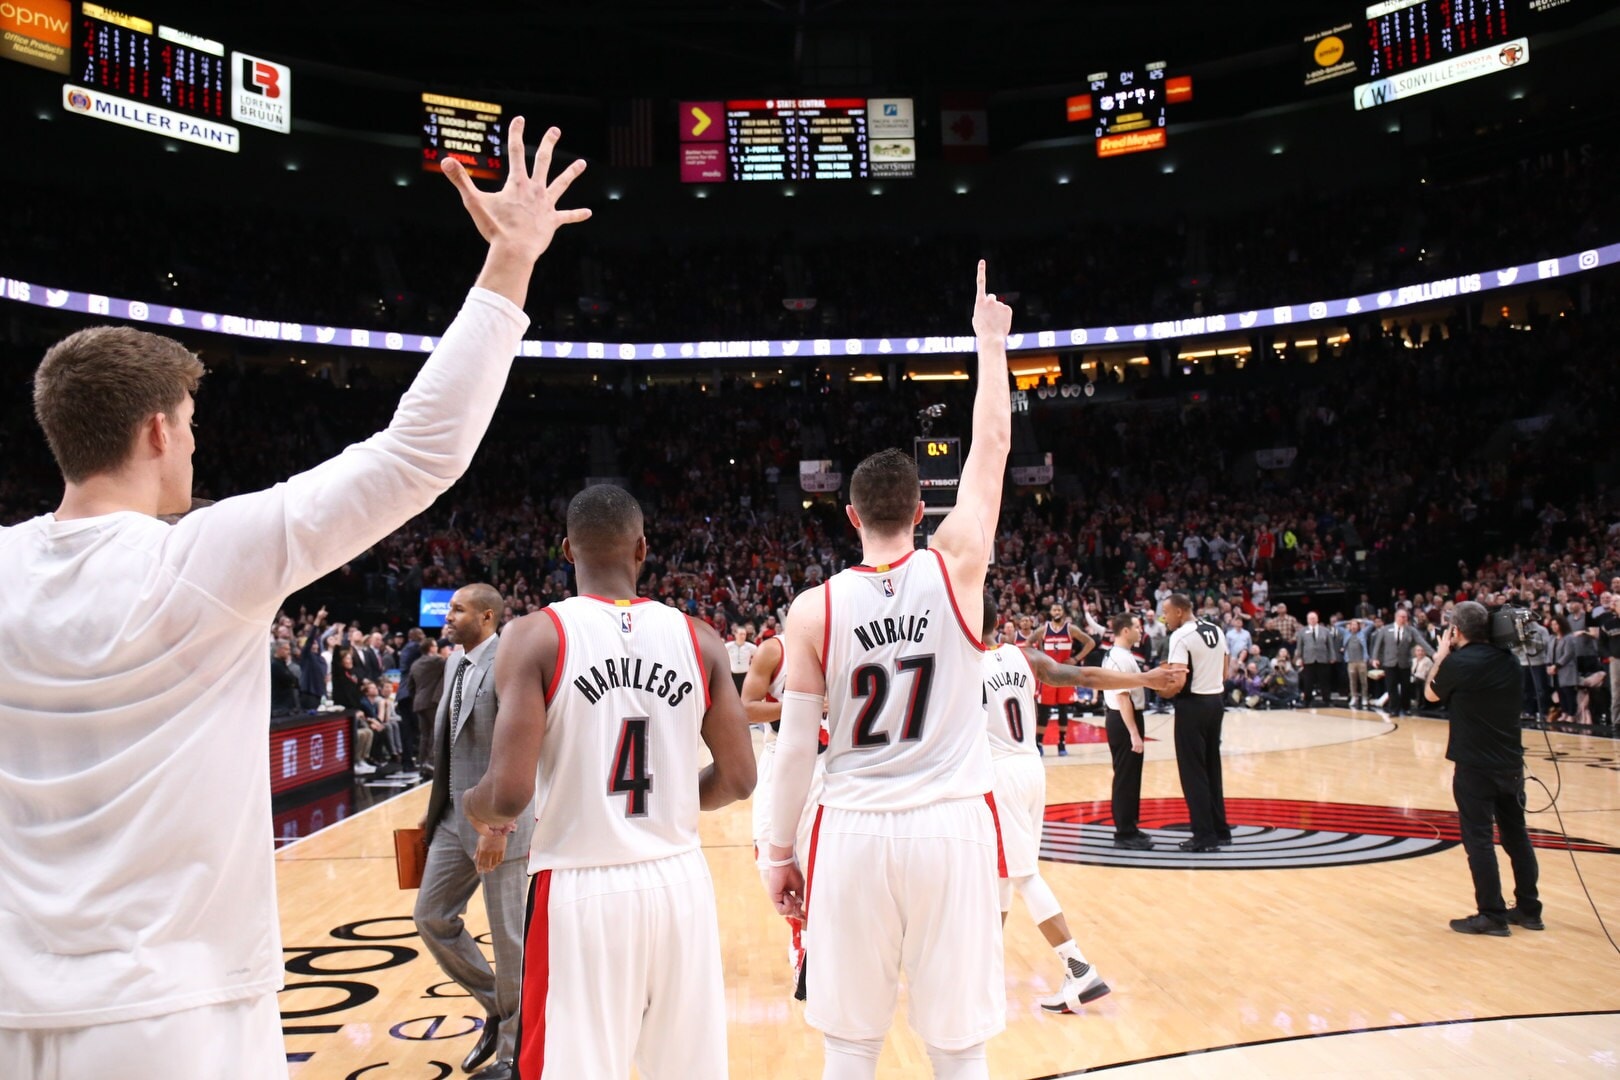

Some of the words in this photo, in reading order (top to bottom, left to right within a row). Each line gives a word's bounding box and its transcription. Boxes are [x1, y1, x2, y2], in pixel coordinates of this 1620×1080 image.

[0, 2, 69, 34] opnw
[1455, 54, 1493, 70] TOYOTA
[1371, 66, 1454, 106] WILSONVILLE
[240, 95, 283, 115] LORENTZ
[240, 105, 283, 124] BRUUN
[95, 100, 172, 129] MILLER
[179, 121, 236, 145] PAINT
[8, 280, 30, 301] US
[1398, 278, 1457, 304] FOLLOW
[1459, 273, 1481, 293] US
[222, 315, 280, 339] FOLLOW
[1152, 317, 1206, 339] FOLLOW
[1206, 315, 1226, 332] US
[927, 442, 948, 456] 0.4
[854, 609, 931, 651] NURKIĆ
[1203, 630, 1217, 646] 71
[573, 657, 693, 707] HARKLESS
[851, 653, 936, 748] 27
[1003, 697, 1024, 743] 0
[606, 716, 653, 818] 4
